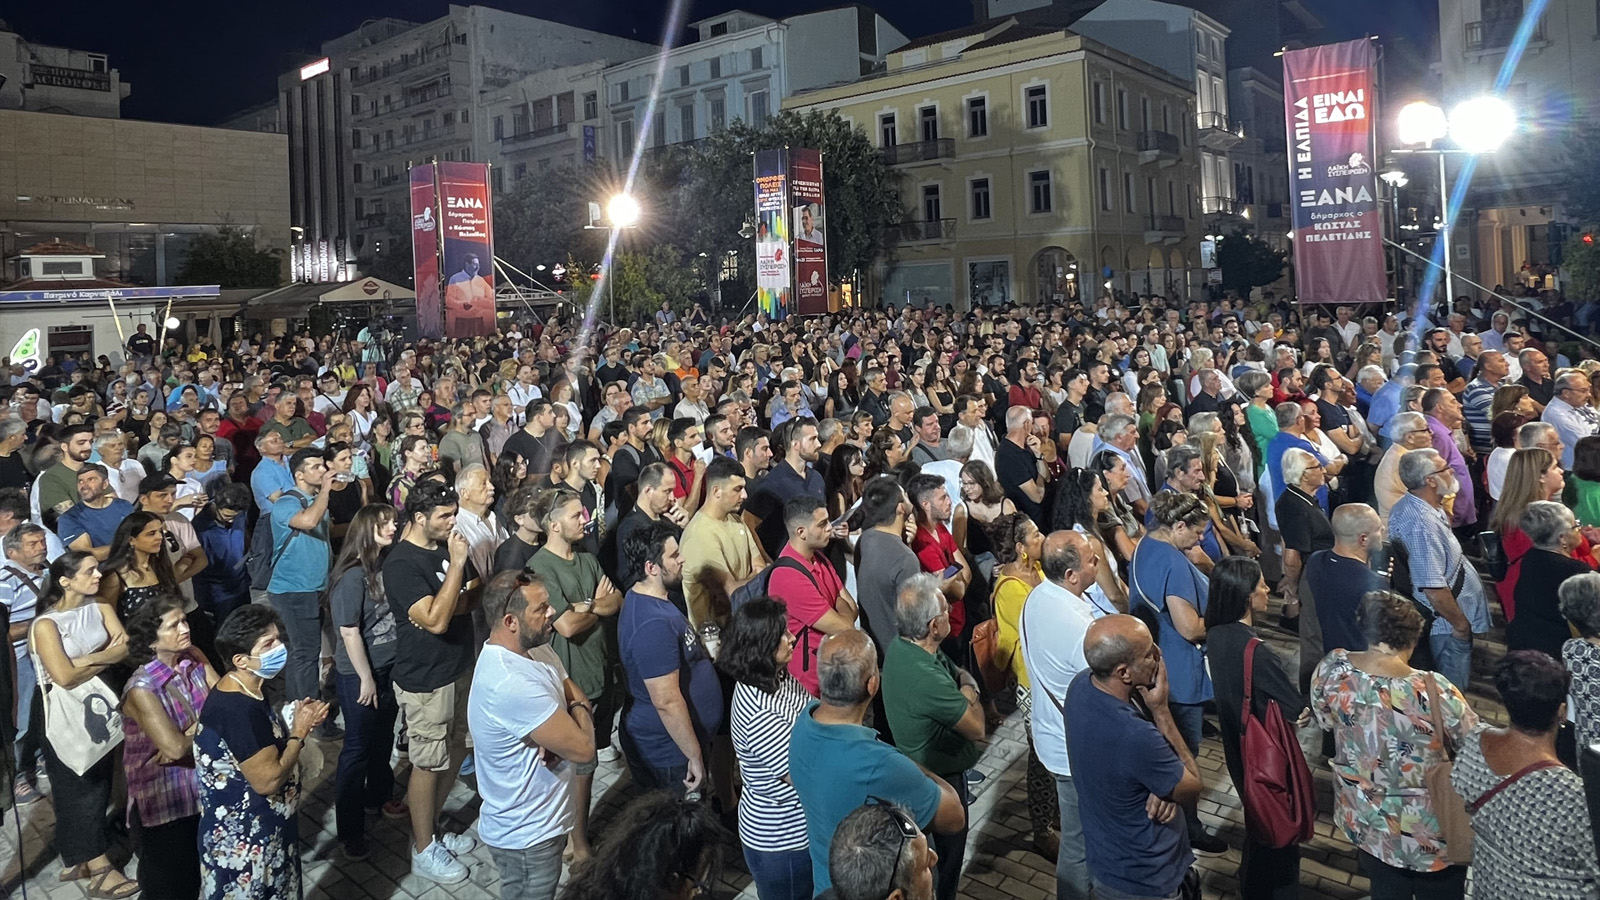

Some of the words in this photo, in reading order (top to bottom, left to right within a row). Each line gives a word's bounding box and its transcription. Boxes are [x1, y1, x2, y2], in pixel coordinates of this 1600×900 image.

[1313, 88, 1364, 108] ΕΙΝΑΙ
[1315, 103, 1365, 124] ΕΔΩ
[1294, 96, 1311, 163] ΕΛΠΙΔΑ
[1298, 168, 1312, 180] Η
[1300, 185, 1373, 207] ΞΑΝΑ
[447, 197, 483, 208] ΞΑΝΑ
[1310, 211, 1355, 221] δήμαρχος
[1314, 220, 1361, 230] ΚΩΣΤΑΣ
[1305, 231, 1372, 242] ΠΕΛΕΤΙΔΗΣ
[43, 292, 78, 300] Πατρινό
